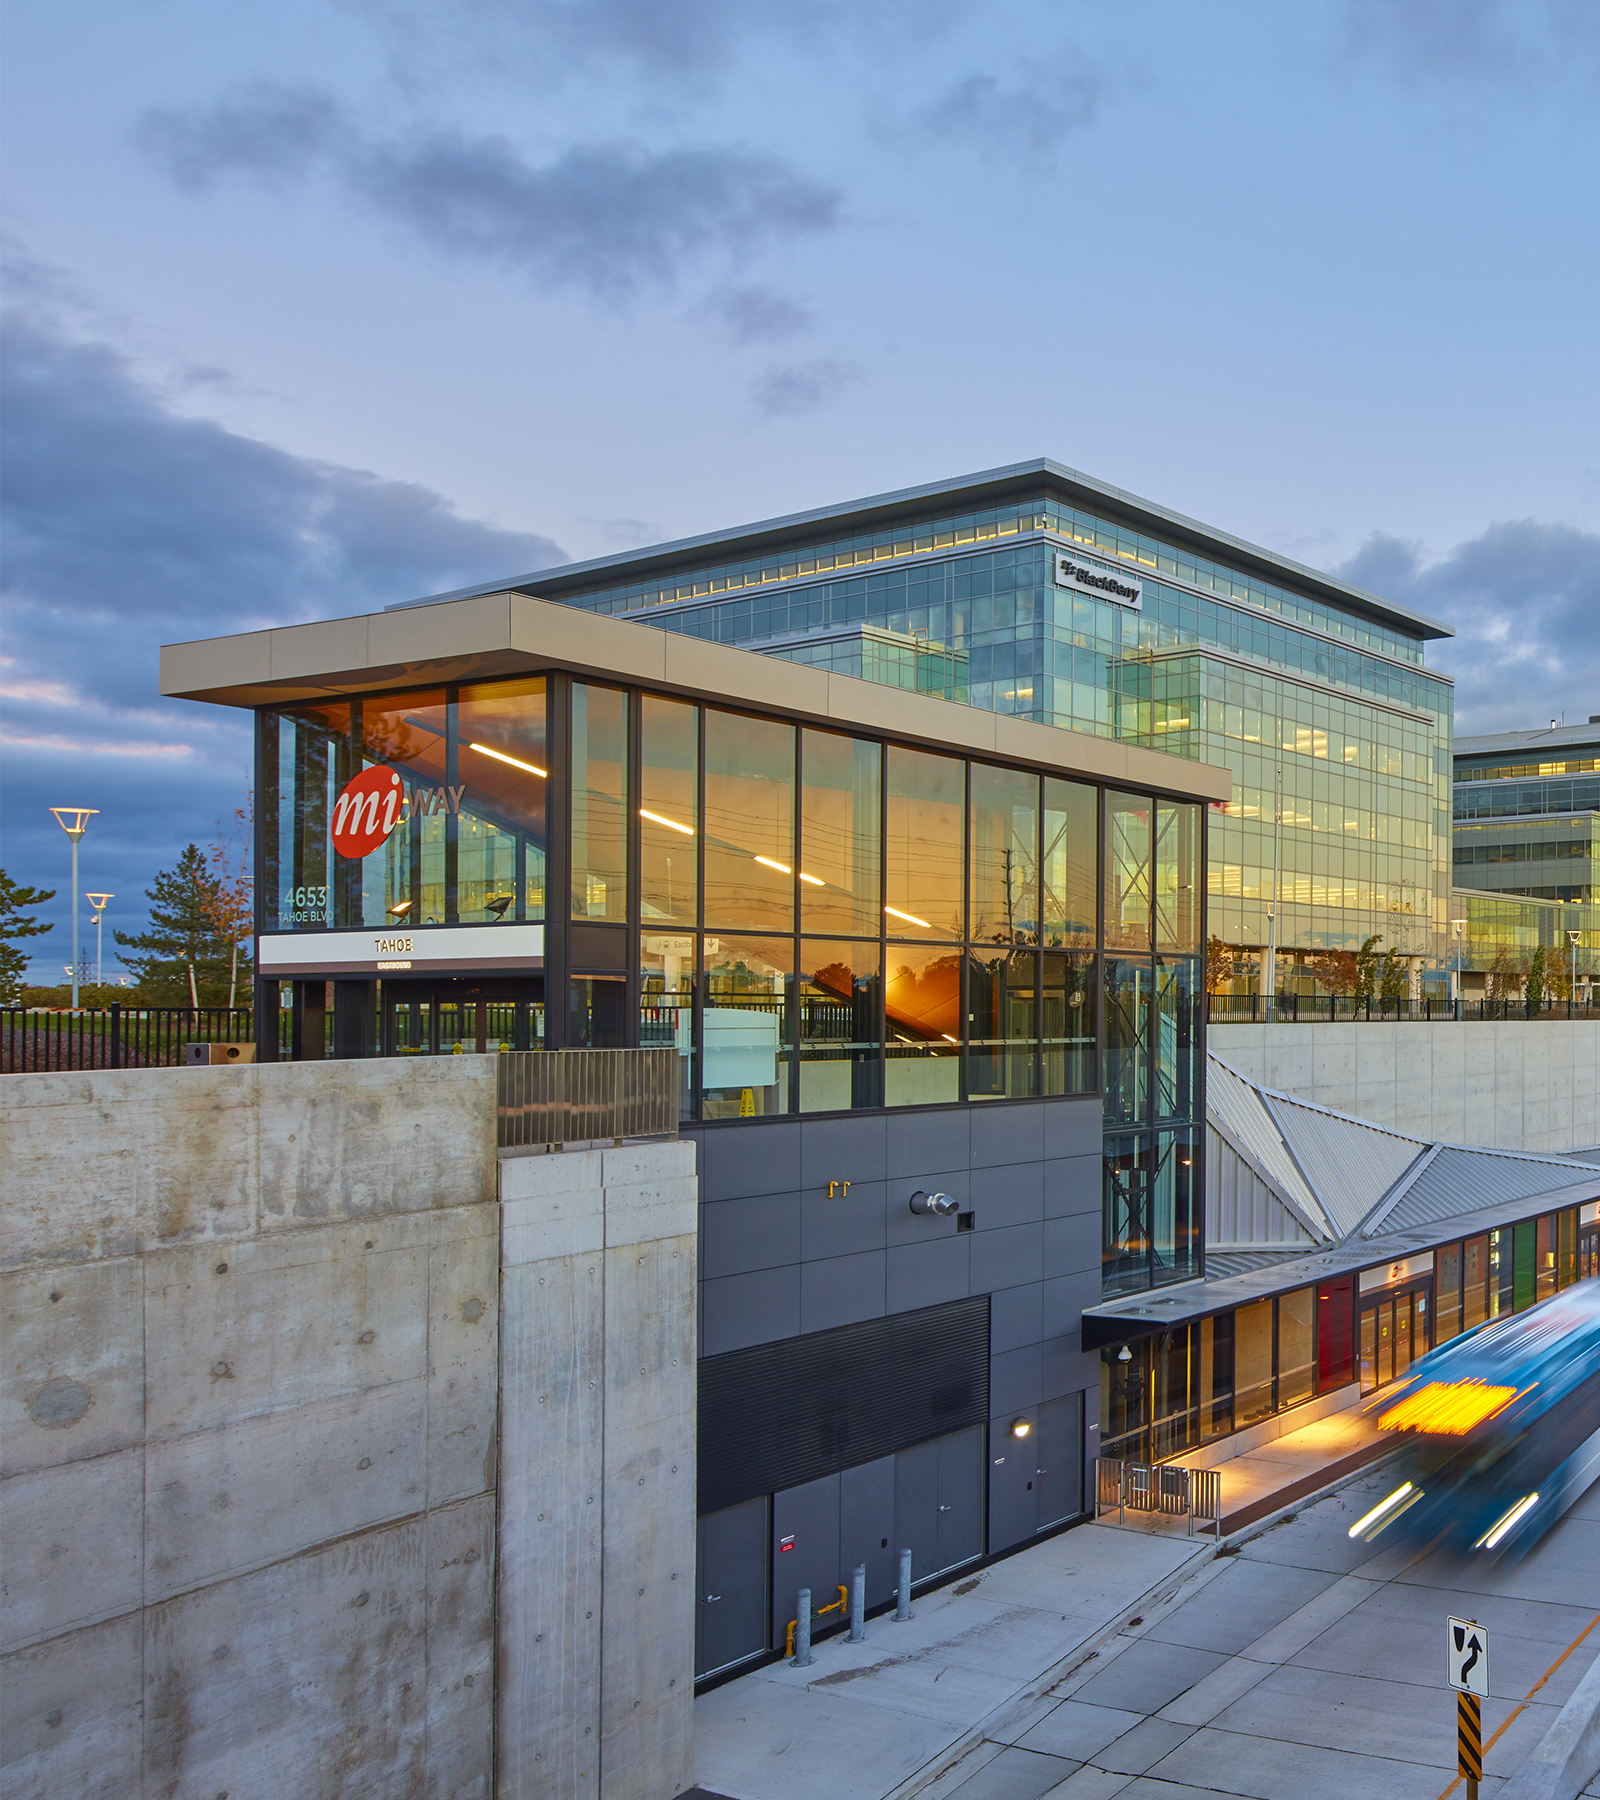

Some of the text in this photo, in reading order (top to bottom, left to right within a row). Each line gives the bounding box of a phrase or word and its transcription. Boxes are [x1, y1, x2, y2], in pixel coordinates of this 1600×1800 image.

[1075, 567, 1140, 603] BlackBerry
[284, 886, 327, 908] 4653
[277, 910, 335, 922] TAHOE BLVD
[374, 938, 413, 953] TAHOE
[673, 940, 693, 949] Eastb
[377, 961, 412, 970] EASTBOUND
